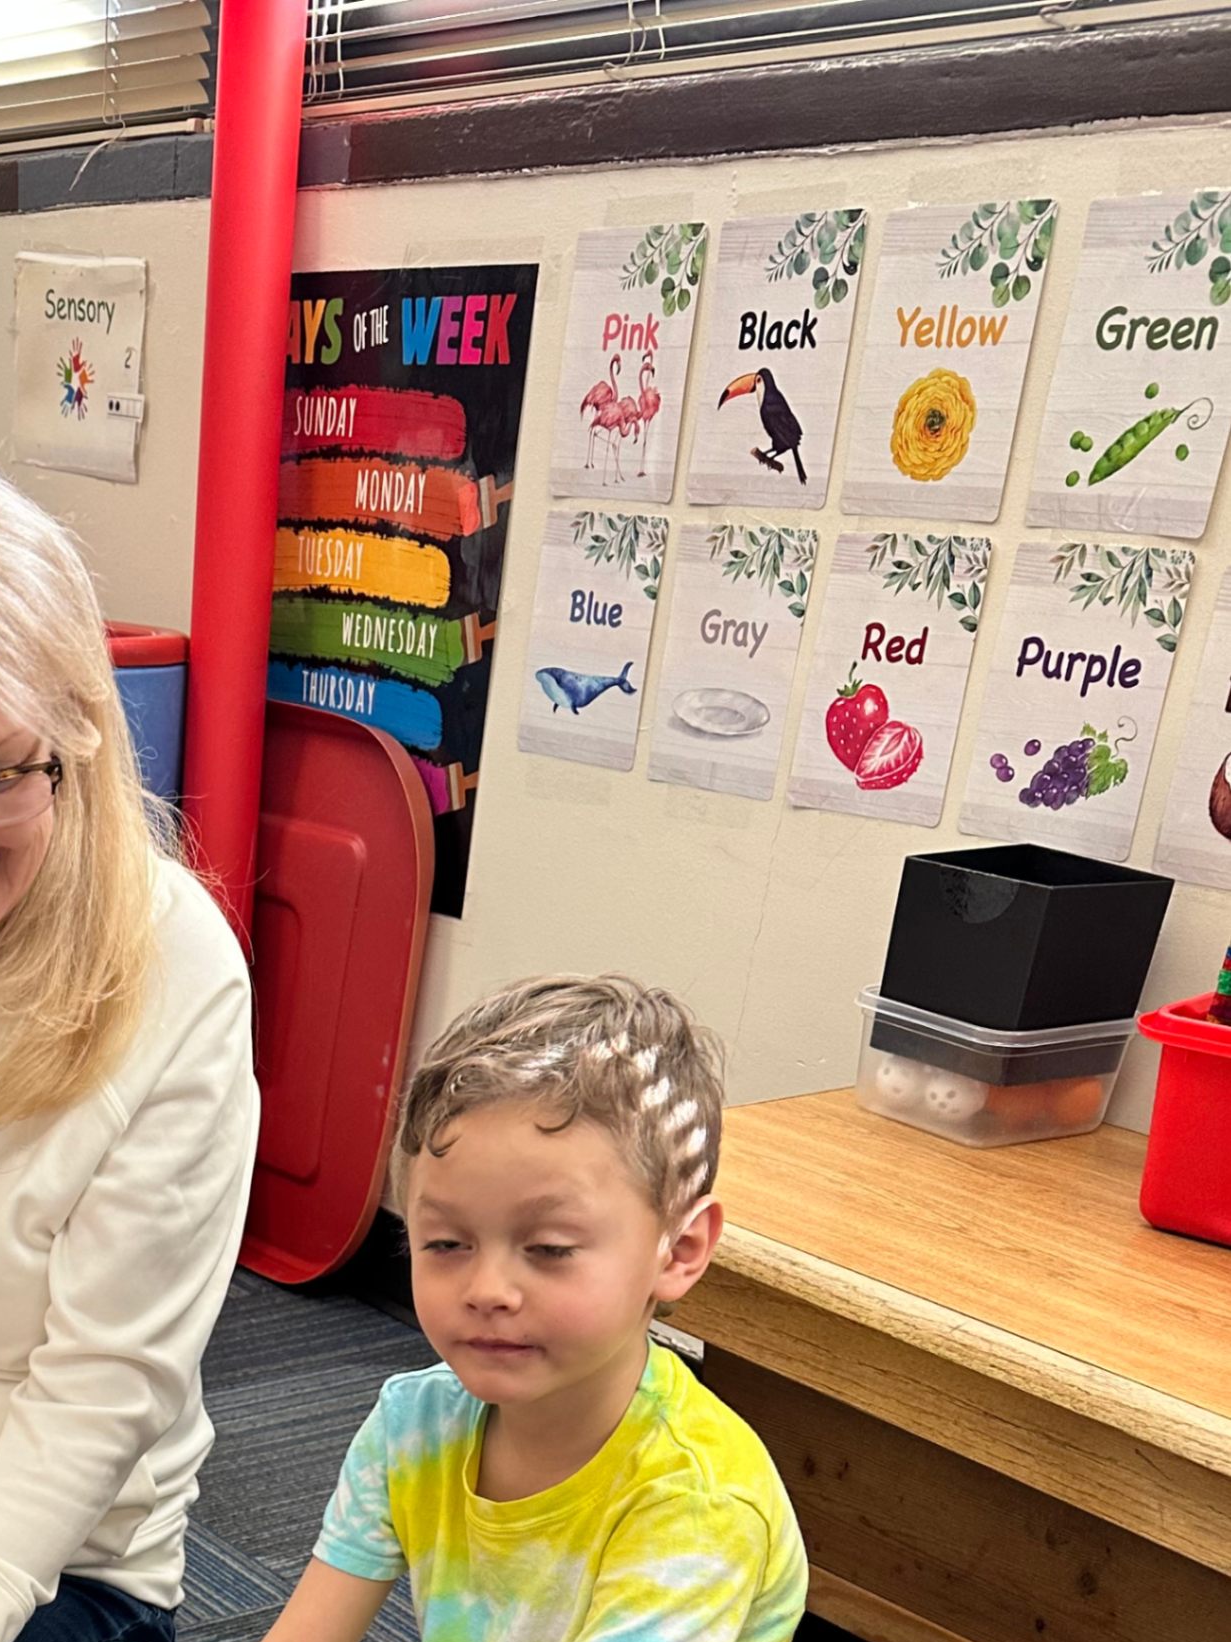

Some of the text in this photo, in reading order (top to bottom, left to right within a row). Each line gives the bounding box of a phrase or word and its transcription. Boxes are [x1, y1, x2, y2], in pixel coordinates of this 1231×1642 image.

[44, 288, 115, 334] Sensory
[285, 293, 518, 366] AYS OF THE WEEK
[602, 312, 660, 351] Pink
[738, 308, 818, 351] Black
[896, 304, 1009, 348] Yellow
[1095, 305, 1220, 351] Green
[123, 346, 136, 370] 2
[293, 395, 357, 438] SUNDAY
[355, 469, 427, 515] MONDAY
[298, 535, 364, 580] TUESDAY
[569, 589, 623, 628] Blue
[342, 612, 438, 660] WEDNESDAY
[700, 608, 769, 659] Gray
[862, 622, 929, 666] Red
[1016, 636, 1142, 698] Purple
[302, 669, 376, 716] THURSDAY
